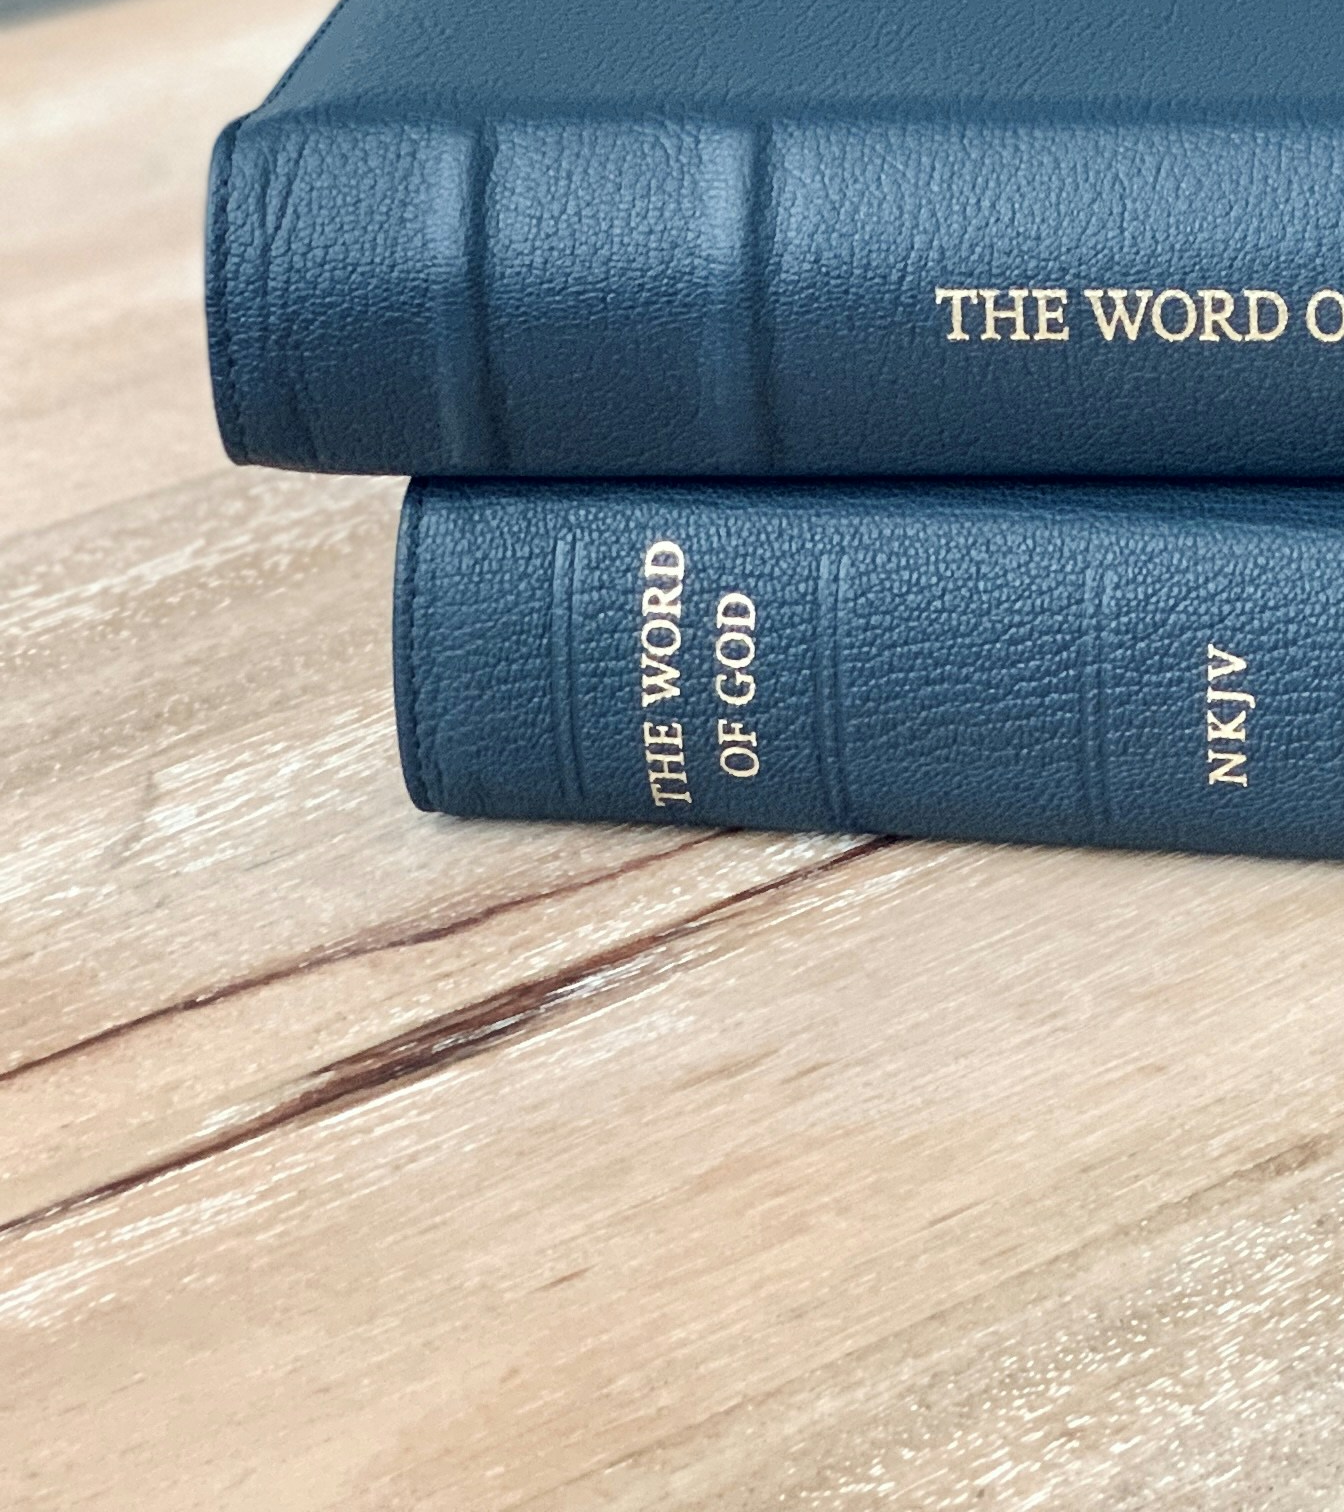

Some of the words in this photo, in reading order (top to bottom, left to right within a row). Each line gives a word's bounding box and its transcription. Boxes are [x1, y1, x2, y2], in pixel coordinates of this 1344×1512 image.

[935, 287, 1069, 342] THE
[1083, 288, 1290, 344] WORD
[640, 539, 686, 708] WORD
[714, 591, 757, 707] GOD
[643, 721, 693, 808] THE
[717, 718, 761, 779] OF
[1206, 643, 1256, 787] NKJV
